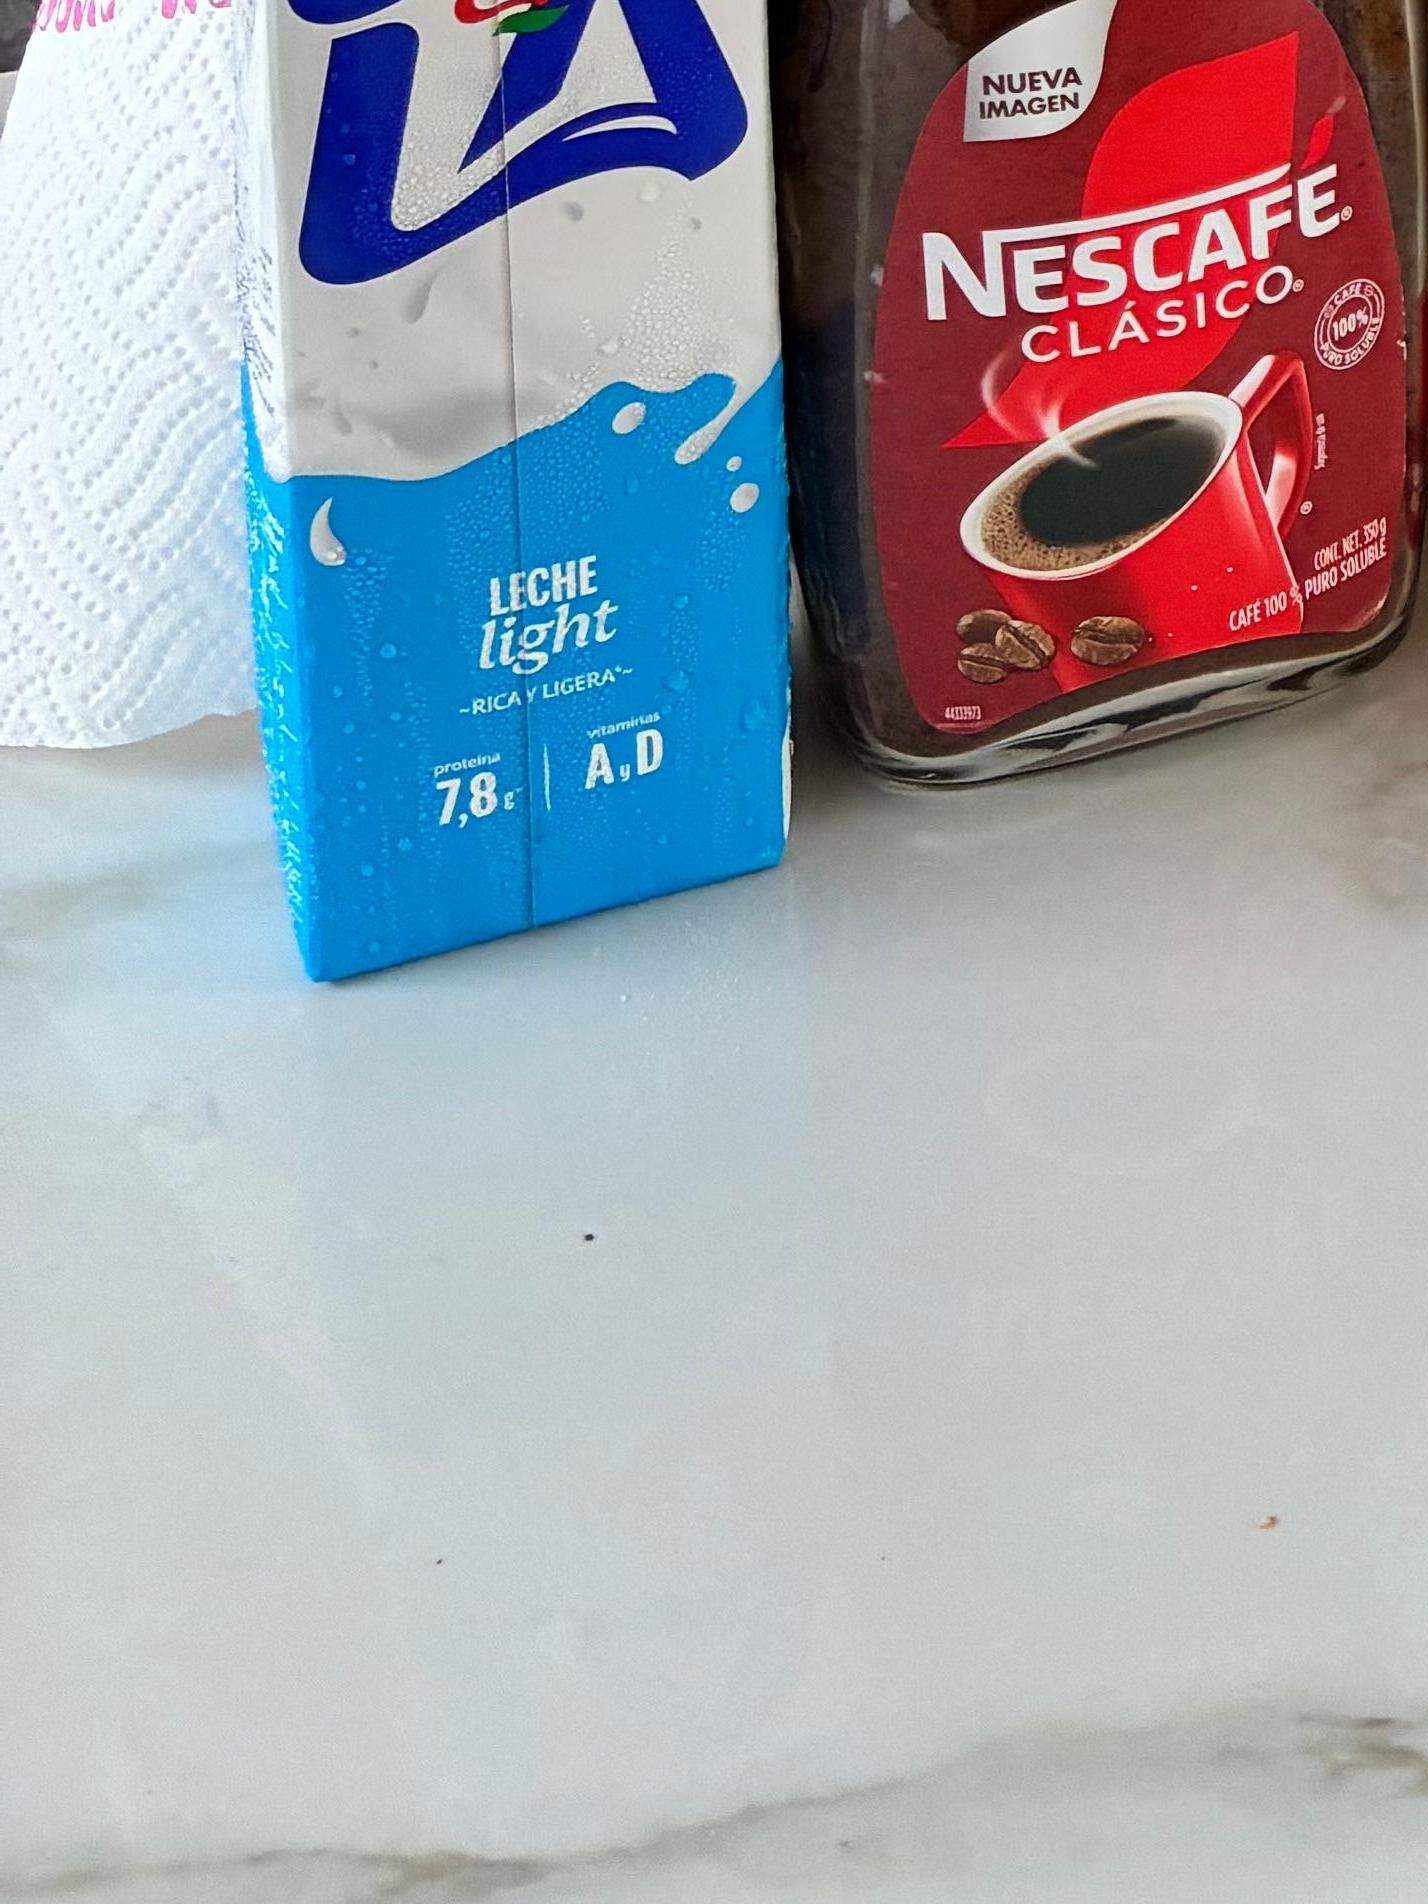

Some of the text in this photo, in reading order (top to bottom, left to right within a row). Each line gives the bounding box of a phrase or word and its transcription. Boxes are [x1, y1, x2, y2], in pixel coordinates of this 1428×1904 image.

[979, 92, 1080, 120] IMAGEN
[982, 67, 1082, 96] NUEVA
[922, 142, 1339, 321] NESCAFÉ
[1021, 265, 1295, 363] CLÁSICO
[1320, 317, 1380, 365] PURO SOLUBLE
[1332, 306, 1369, 341] 100%
[1314, 517, 1387, 571] CONT. NET. 350 g
[490, 555, 598, 616] LECHE
[1229, 538, 1387, 632] CAFÉ 100 % PURO SOLUBLE
[479, 599, 619, 675] light
[472, 691, 522, 716] RICA
[526, 688, 537, 702] Y
[586, 711, 661, 739] vitaminas
[584, 728, 664, 790] A y D
[436, 771, 497, 828] 7,8
